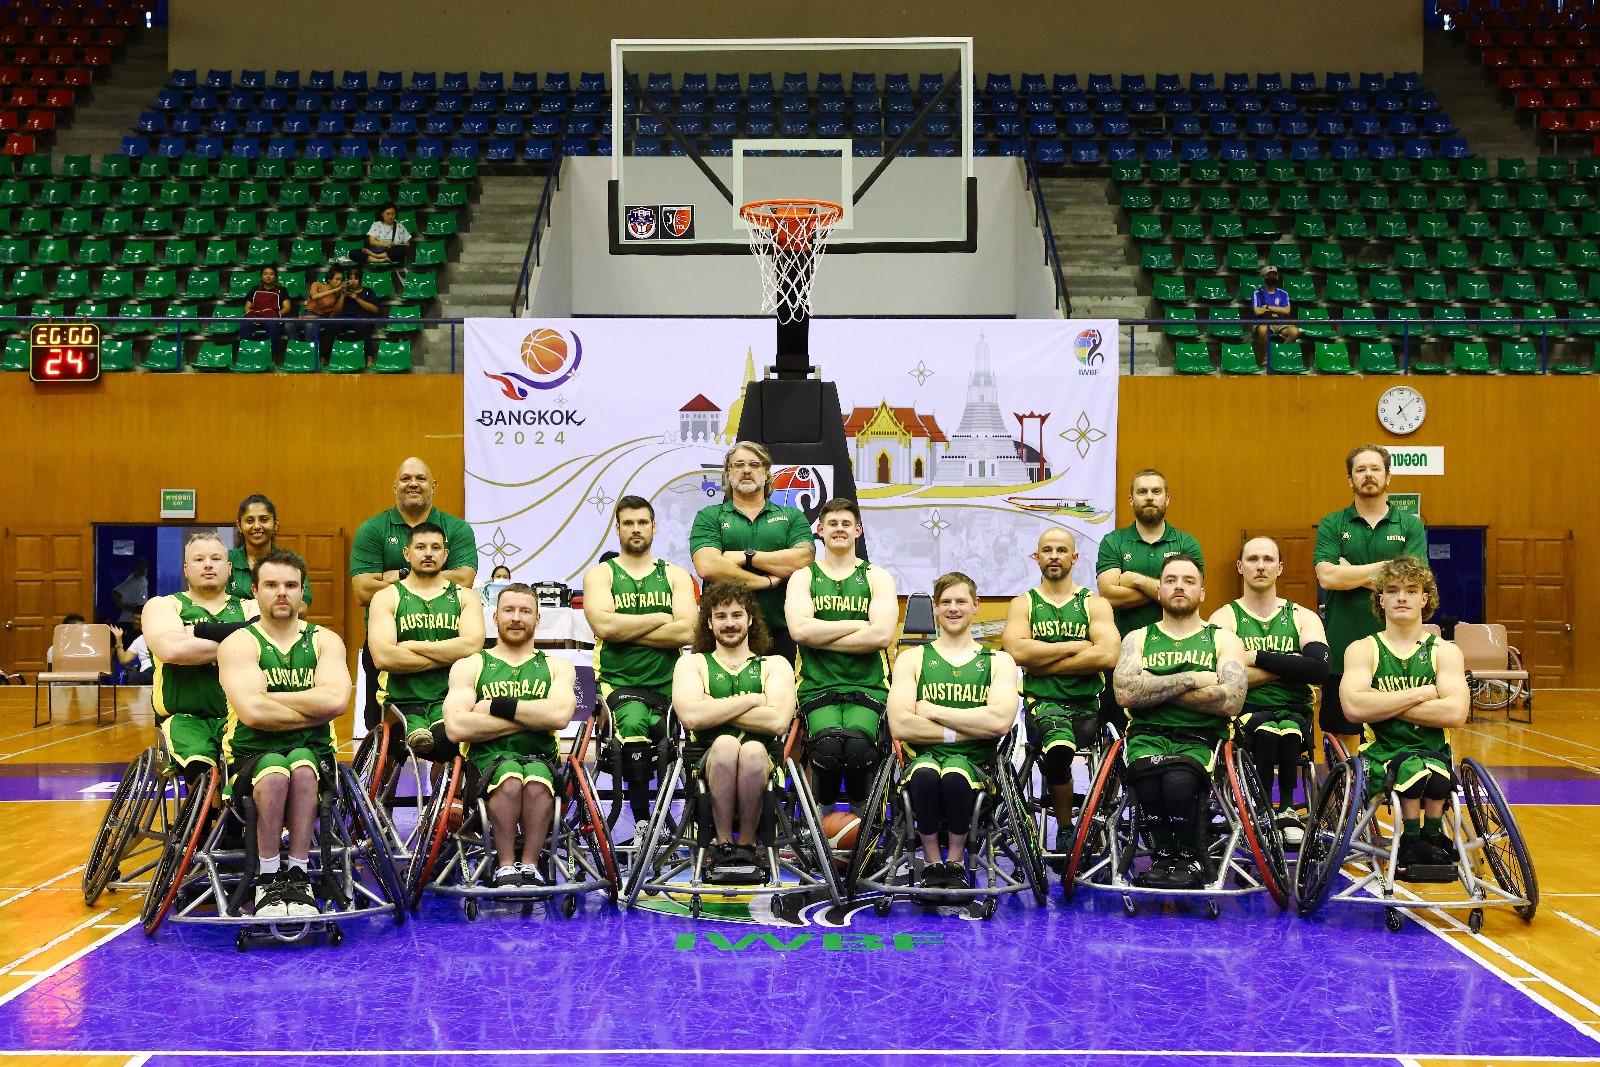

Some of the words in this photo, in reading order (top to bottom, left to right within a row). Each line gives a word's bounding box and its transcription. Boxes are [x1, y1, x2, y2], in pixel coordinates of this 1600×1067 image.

[36, 327, 93, 345] 20:00
[45, 348, 83, 375] 24
[475, 409, 586, 427] BANGKOK
[494, 431, 565, 445] 2024
[1390, 453, 1428, 467] างออก
[615, 591, 672, 610] AUSRALIA
[1032, 620, 1087, 639] AUSTALIA
[1240, 634, 1294, 652] USTALIA
[1142, 649, 1214, 670] AUSTRALIA
[481, 678, 547, 700] AUSTRAIA
[922, 682, 990, 703] AUSTRALIA
[673, 933, 945, 951] IWBF
